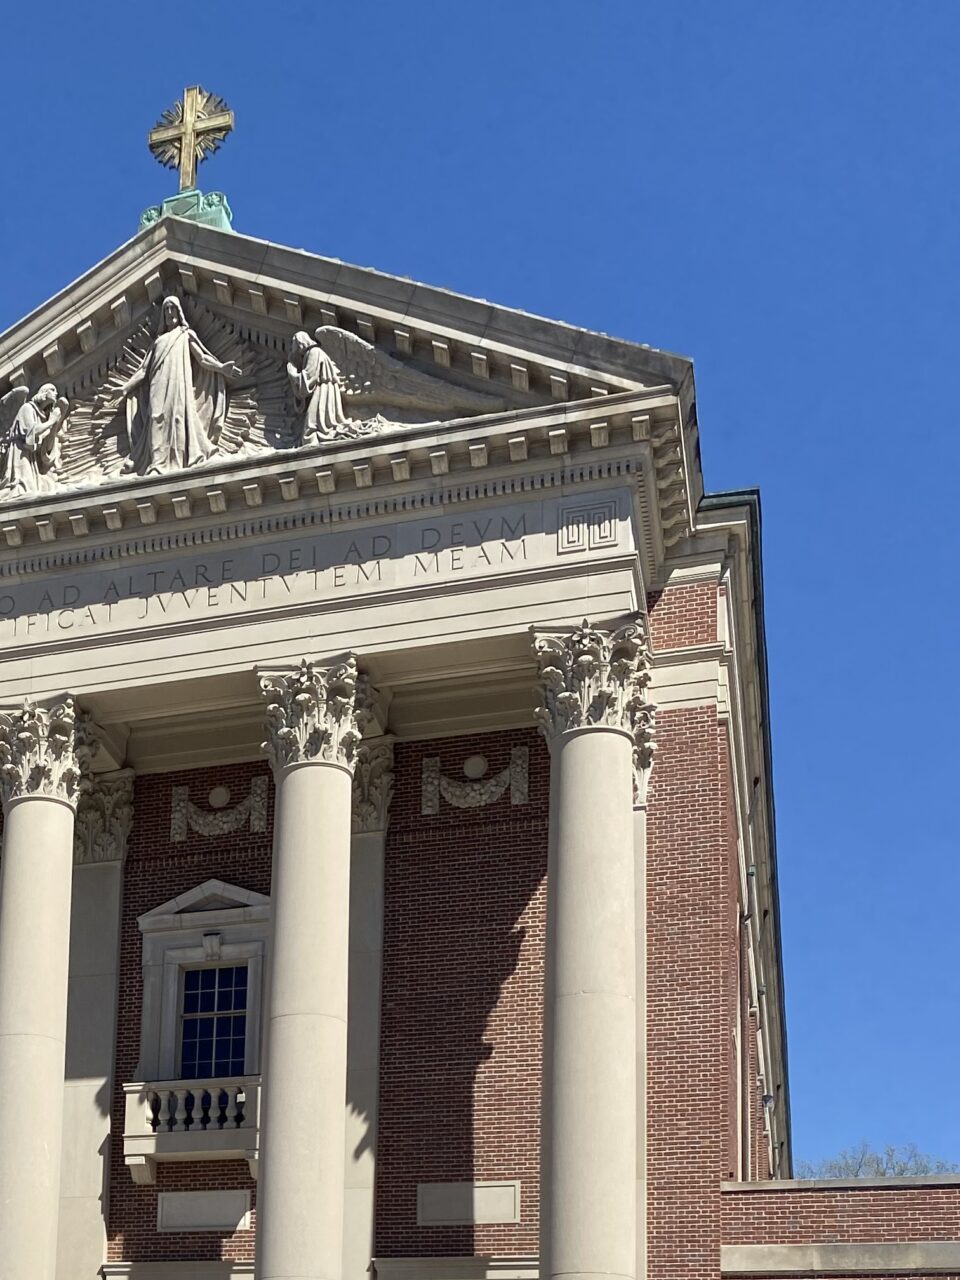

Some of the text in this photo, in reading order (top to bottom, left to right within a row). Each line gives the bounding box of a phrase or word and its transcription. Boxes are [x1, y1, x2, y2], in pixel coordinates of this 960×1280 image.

[38, 585, 81, 609] AD
[104, 560, 234, 599] ALTARE
[262, 546, 317, 574] DEI
[344, 535, 391, 562] AD
[421, 513, 527, 550] DEVM
[138, 560, 382, 619] JVVENTVTEM
[414, 538, 528, 577] MEAM
